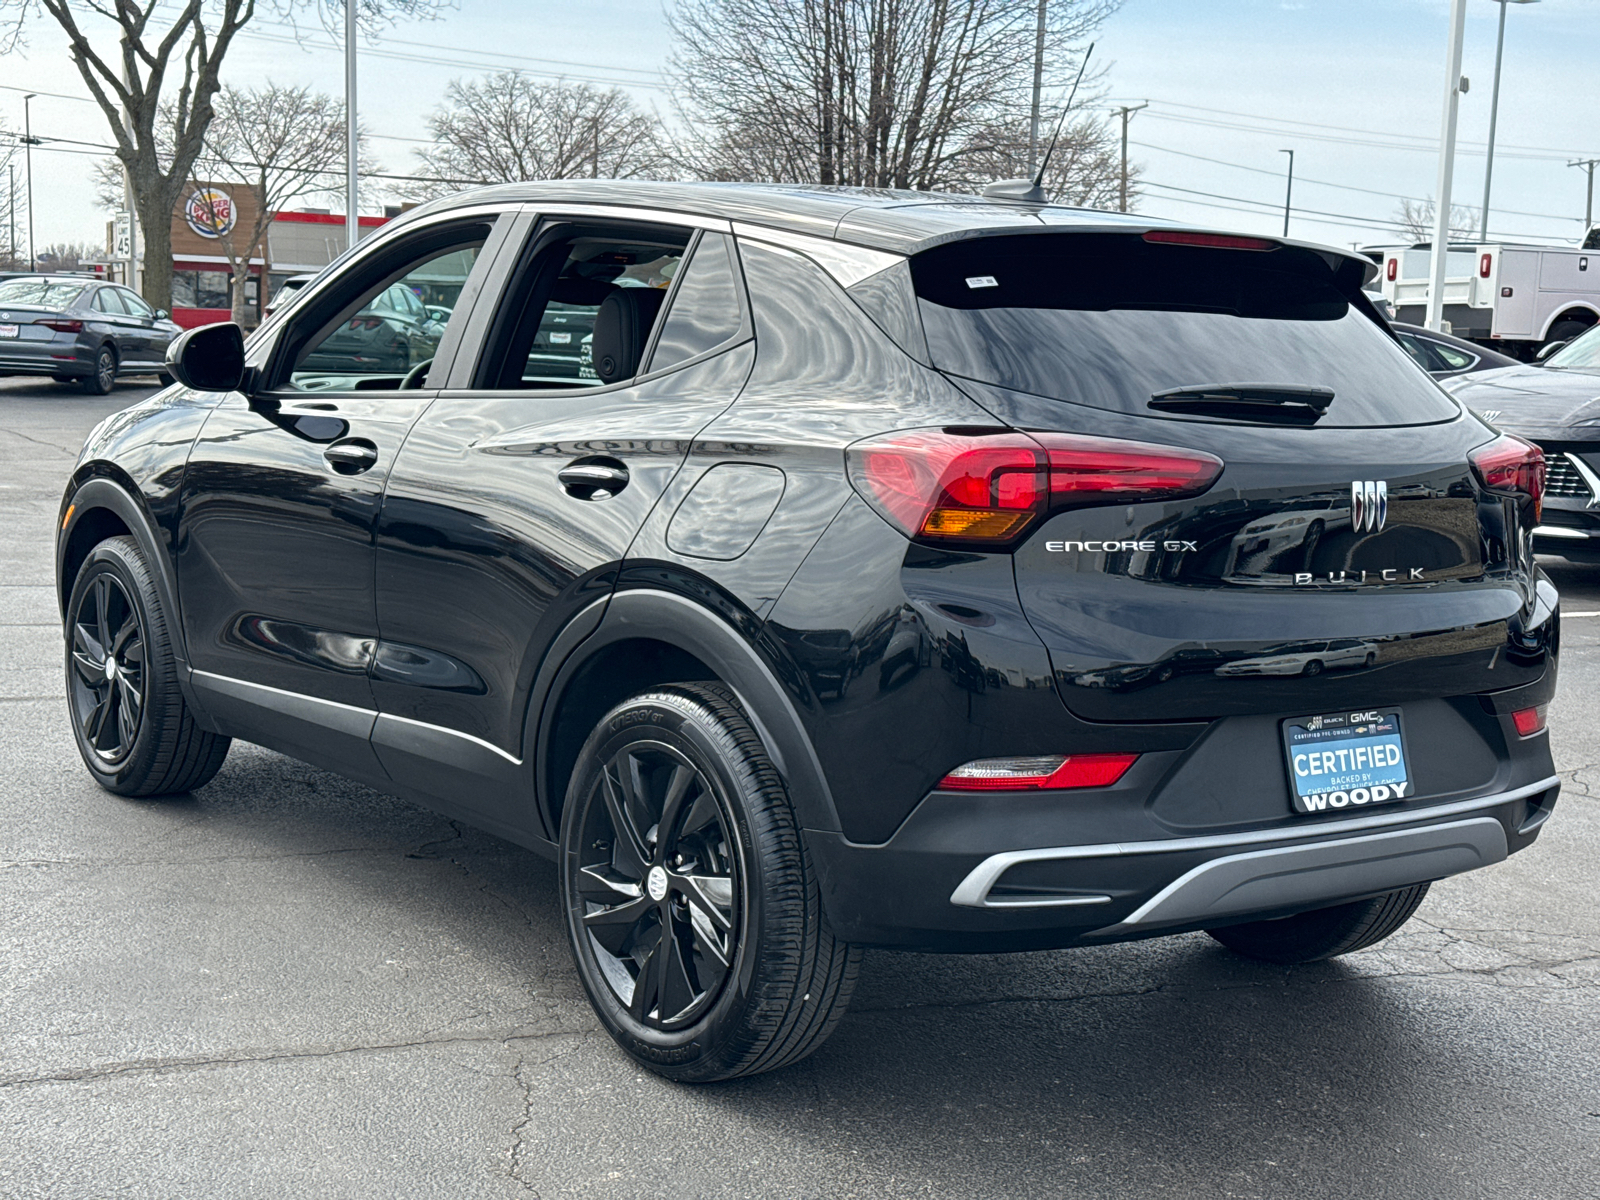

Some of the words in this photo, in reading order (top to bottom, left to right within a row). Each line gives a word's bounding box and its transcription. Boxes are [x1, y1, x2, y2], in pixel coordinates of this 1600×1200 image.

[193, 199, 229, 213] BGER
[118, 237, 130, 255] 45
[1045, 541, 1156, 552] ENCORE
[1163, 541, 1198, 552] GX
[1295, 568, 1425, 585] BUICK
[610, 709, 652, 731] KINERGY
[652, 713, 664, 723] GT
[1350, 711, 1378, 723] GMC
[1294, 744, 1400, 777] CERTIFIED
[1331, 774, 1360, 785] BACKED
[1362, 773, 1372, 782] BY
[1302, 782, 1408, 812] WOODY
